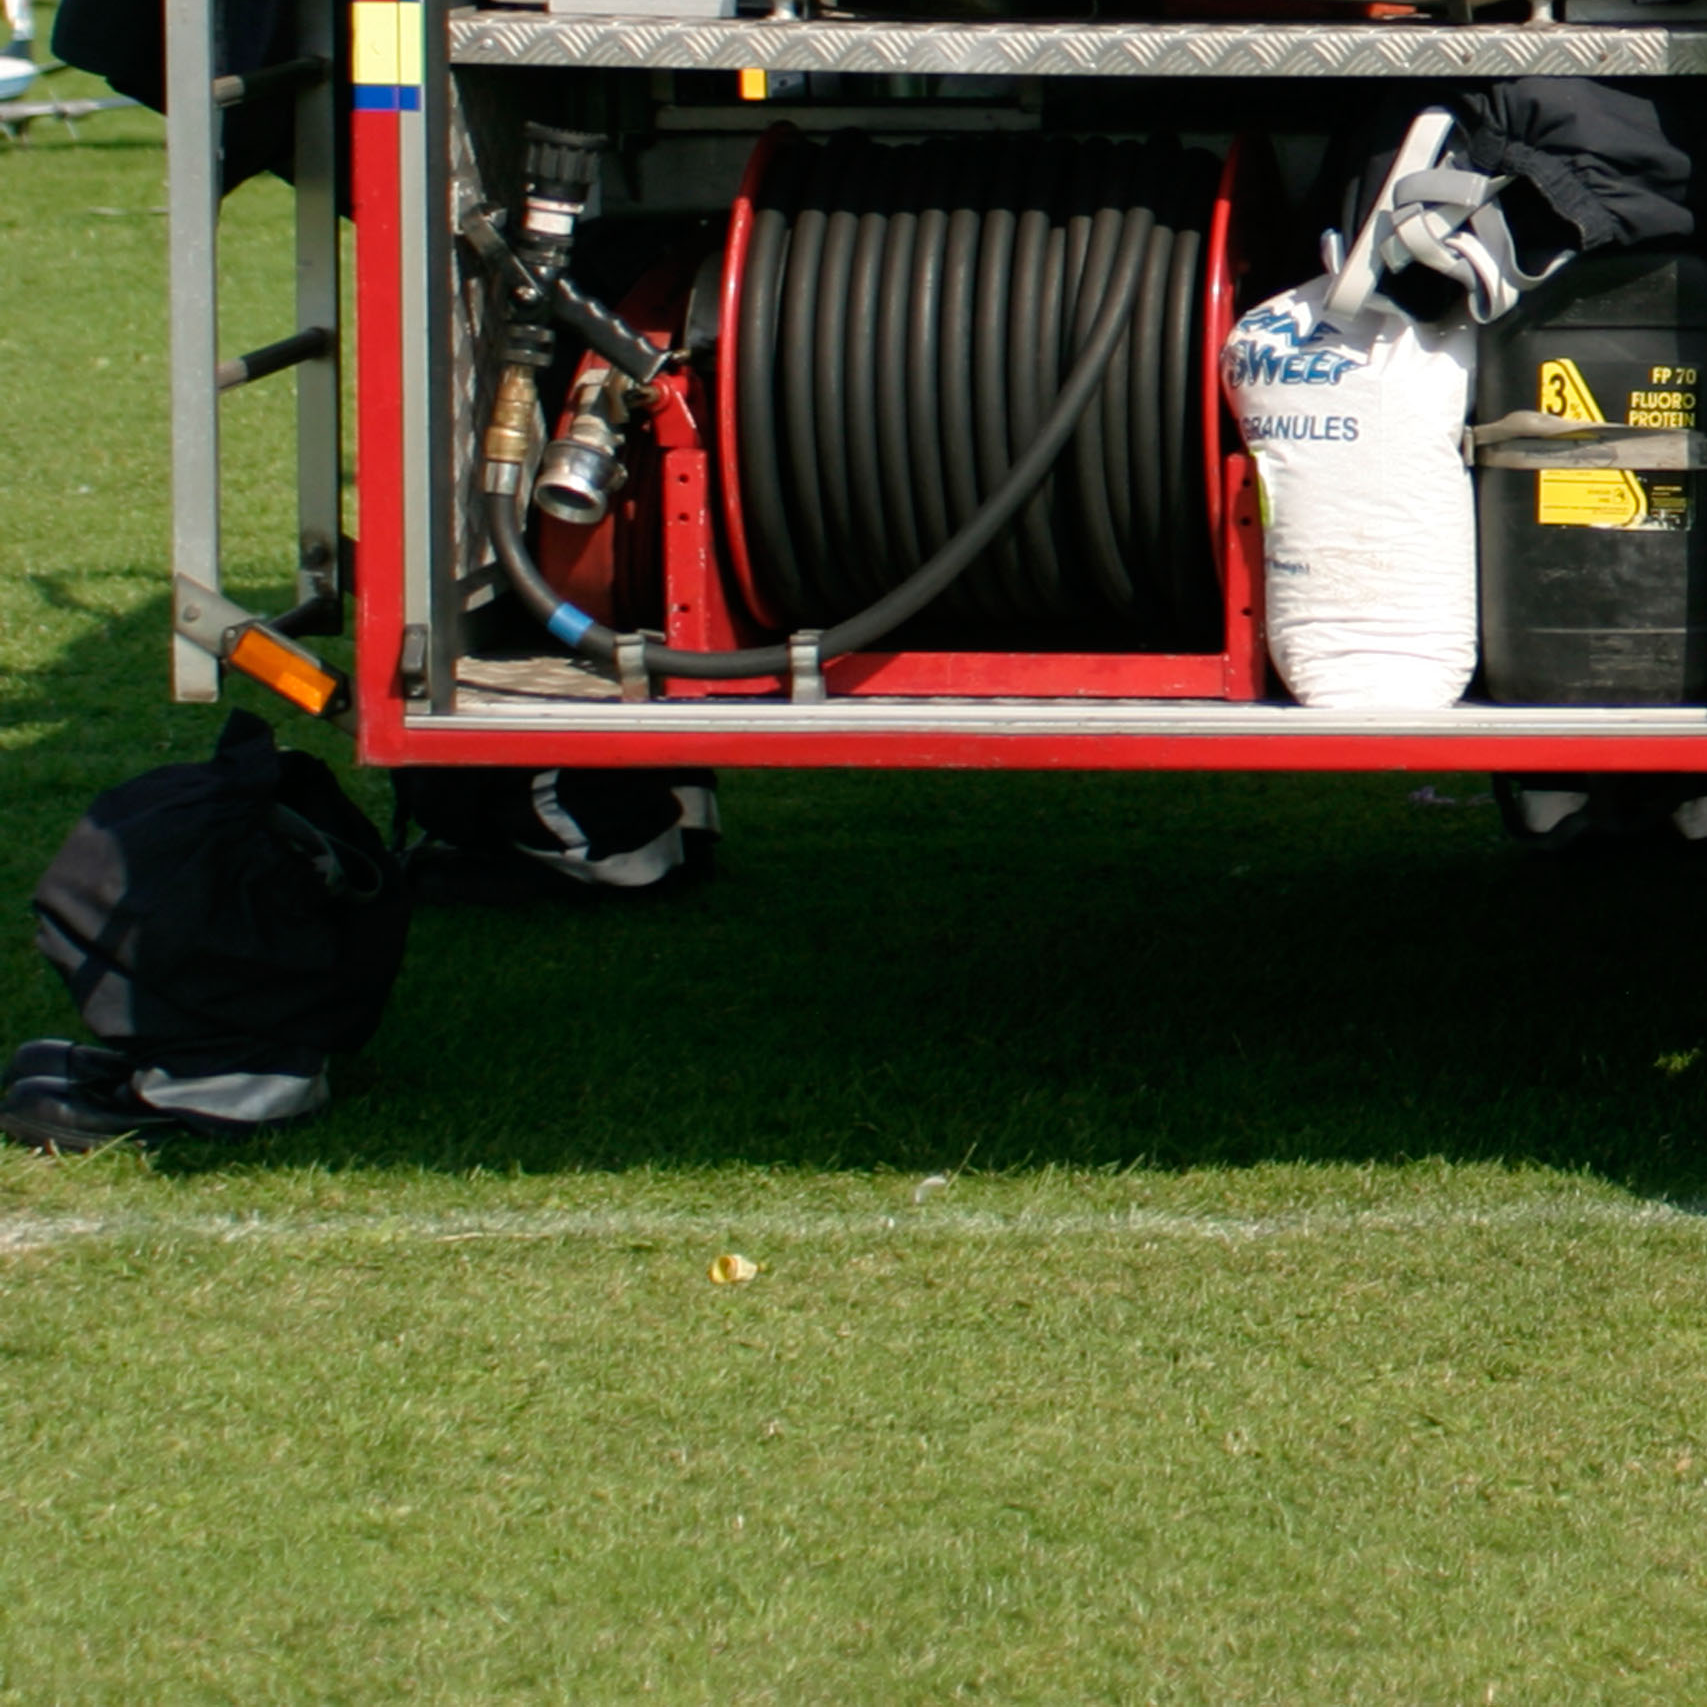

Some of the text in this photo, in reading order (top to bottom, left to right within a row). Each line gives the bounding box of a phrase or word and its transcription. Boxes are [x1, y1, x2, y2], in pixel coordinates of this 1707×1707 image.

[1652, 367, 1697, 385] FP 70
[1631, 392, 1697, 410] FLUORO
[1629, 411, 1696, 428] PROTEIN
